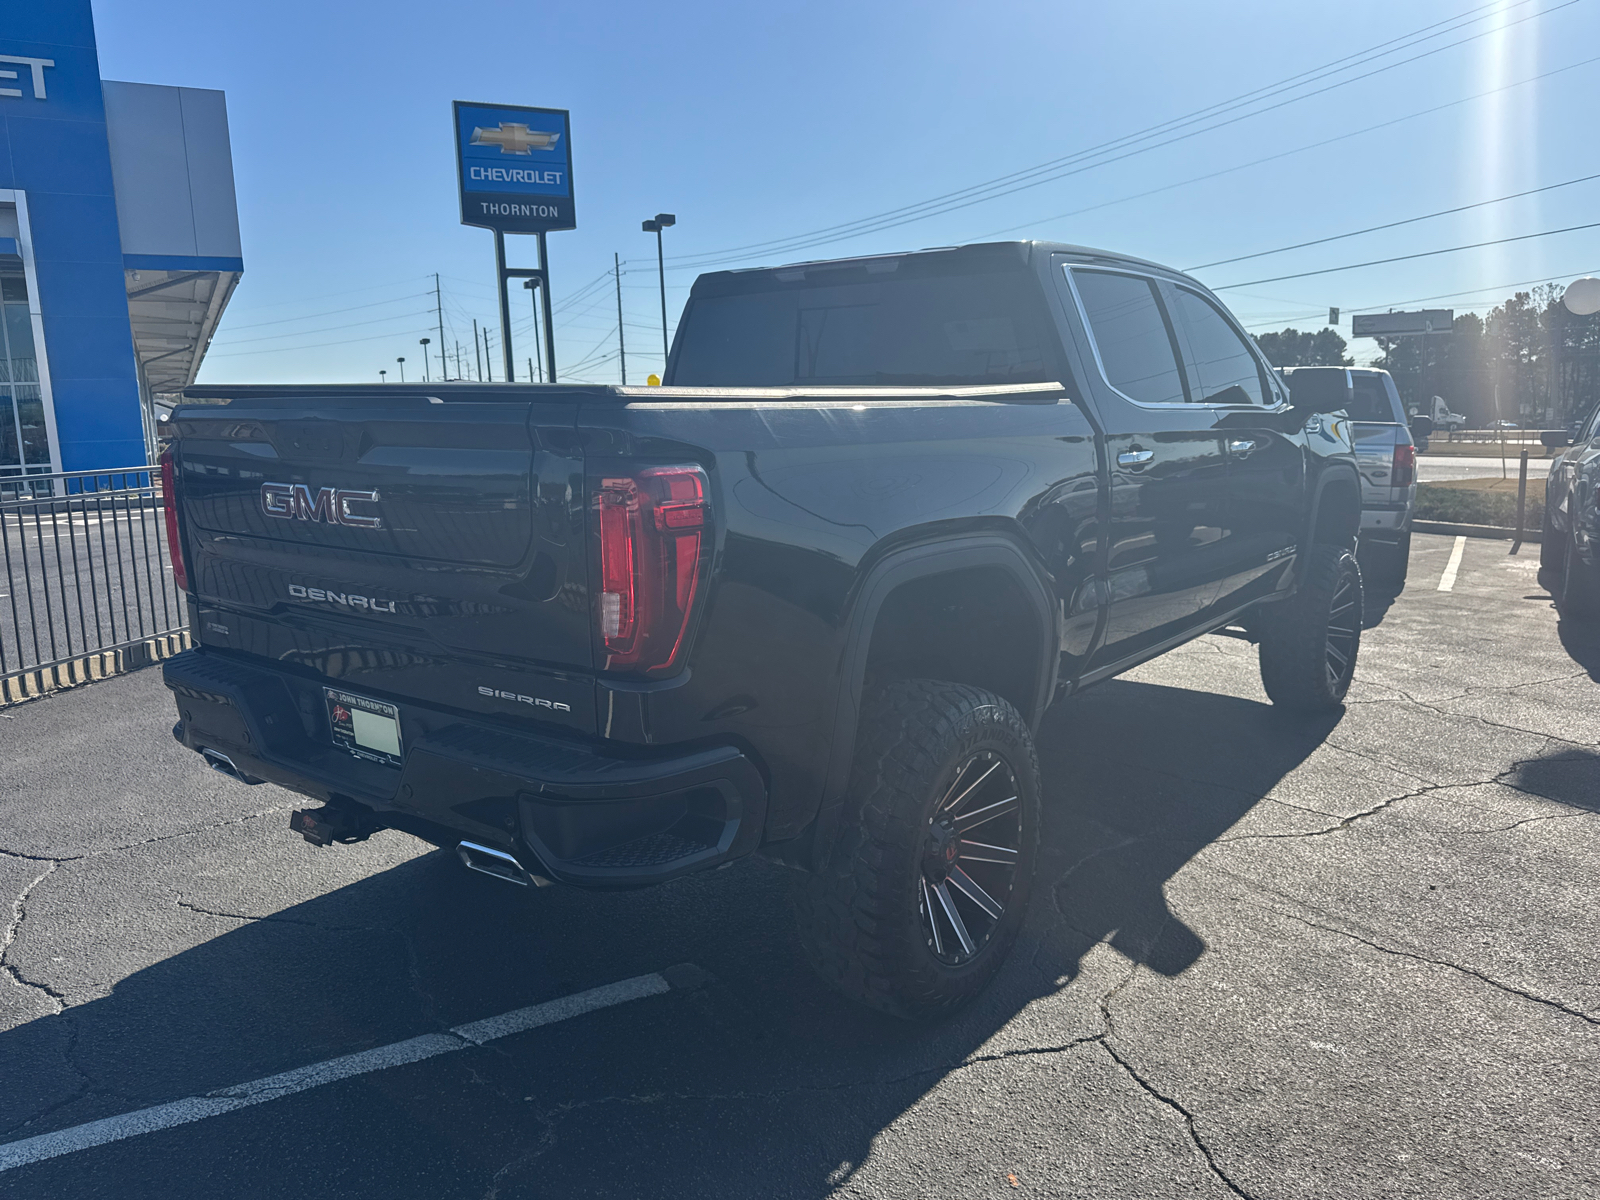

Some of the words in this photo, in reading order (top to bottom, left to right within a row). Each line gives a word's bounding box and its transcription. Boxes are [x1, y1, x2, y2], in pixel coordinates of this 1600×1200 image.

[470, 166, 563, 185] CHEVROLET
[480, 202, 559, 218] THORNTON
[260, 481, 381, 528] GMC
[288, 583, 396, 613] DENALI
[339, 693, 357, 705] JOHN
[357, 698, 394, 715] THORNTON
[478, 686, 571, 712] SIERRA
